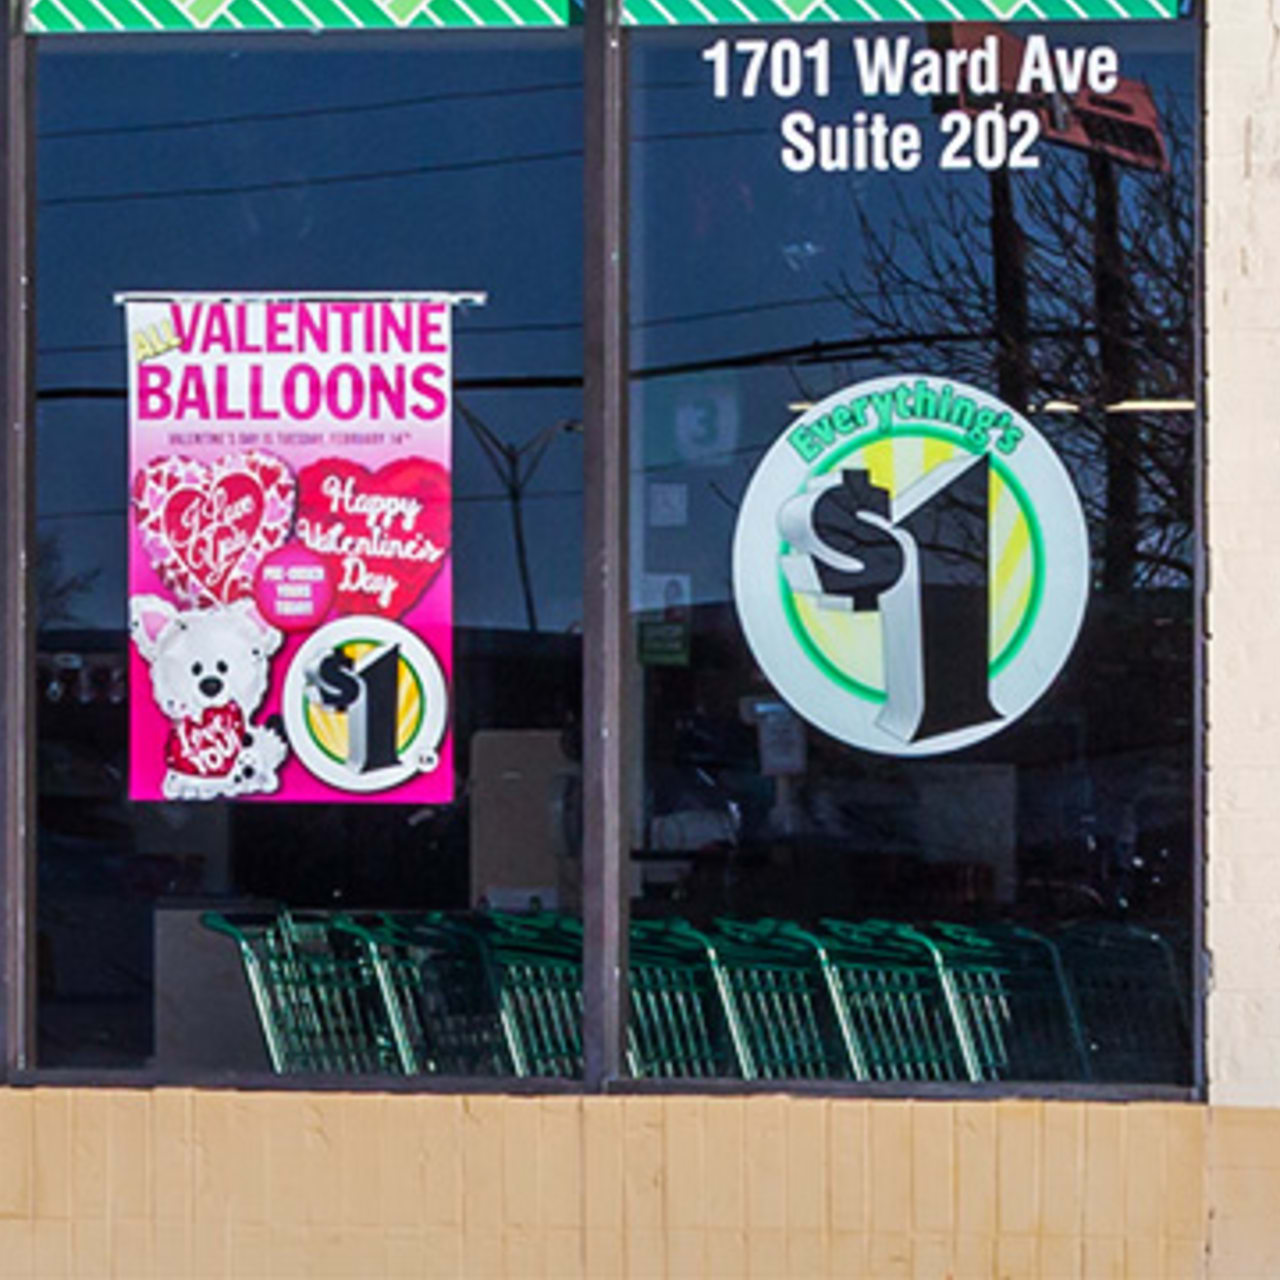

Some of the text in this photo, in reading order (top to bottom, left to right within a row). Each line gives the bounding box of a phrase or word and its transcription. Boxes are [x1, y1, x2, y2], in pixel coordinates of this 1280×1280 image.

[701, 33, 1120, 98] 1701 Ward Ave
[780, 109, 1041, 173] Suite 202
[133, 319, 182, 361] ALL
[170, 302, 448, 354] VALENTINE
[136, 361, 448, 422] BALLOONS
[787, 381, 1026, 463] Everything's
[321, 475, 424, 531] Happy
[295, 516, 445, 564] Valentine's
[337, 556, 400, 609] Day
[809, 452, 1008, 745] $1
[319, 643, 403, 774] $1
